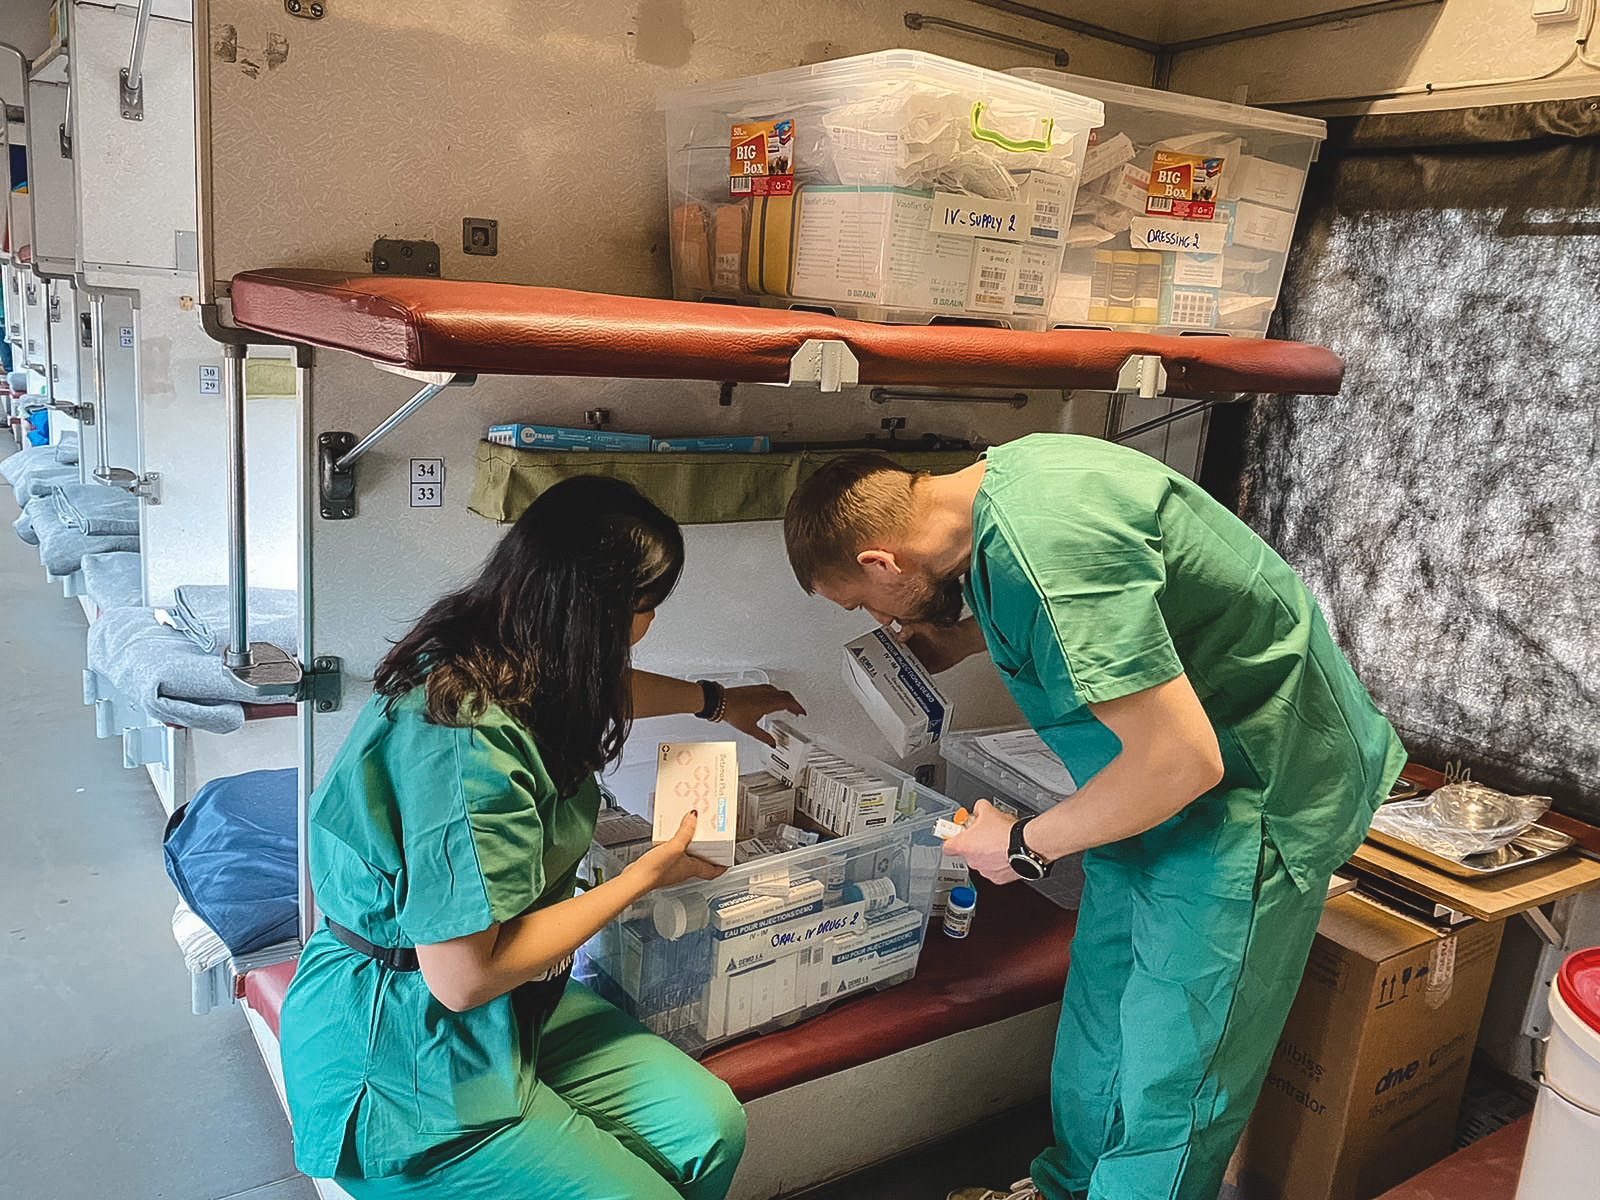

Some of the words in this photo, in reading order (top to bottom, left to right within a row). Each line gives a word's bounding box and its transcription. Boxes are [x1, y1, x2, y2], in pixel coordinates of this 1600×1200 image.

[736, 145, 757, 160] BIG
[743, 161, 764, 175] Box
[1157, 170, 1181, 184] BIG
[1164, 184, 1188, 198] Box
[1008, 214, 1016, 232] 2
[1147, 228, 1190, 248] DRESSING
[1192, 232, 1200, 249] 2
[204, 368, 215, 377] 30
[205, 382, 216, 390] 29
[417, 463, 435, 477] 34
[417, 487, 435, 501] 33
[876, 631, 887, 645] EAU
[724, 929, 739, 939] EAU
[739, 922, 759, 935] POUR
[804, 927, 817, 940] IV
[816, 916, 848, 936] DRUGS
[849, 911, 860, 926] 2
